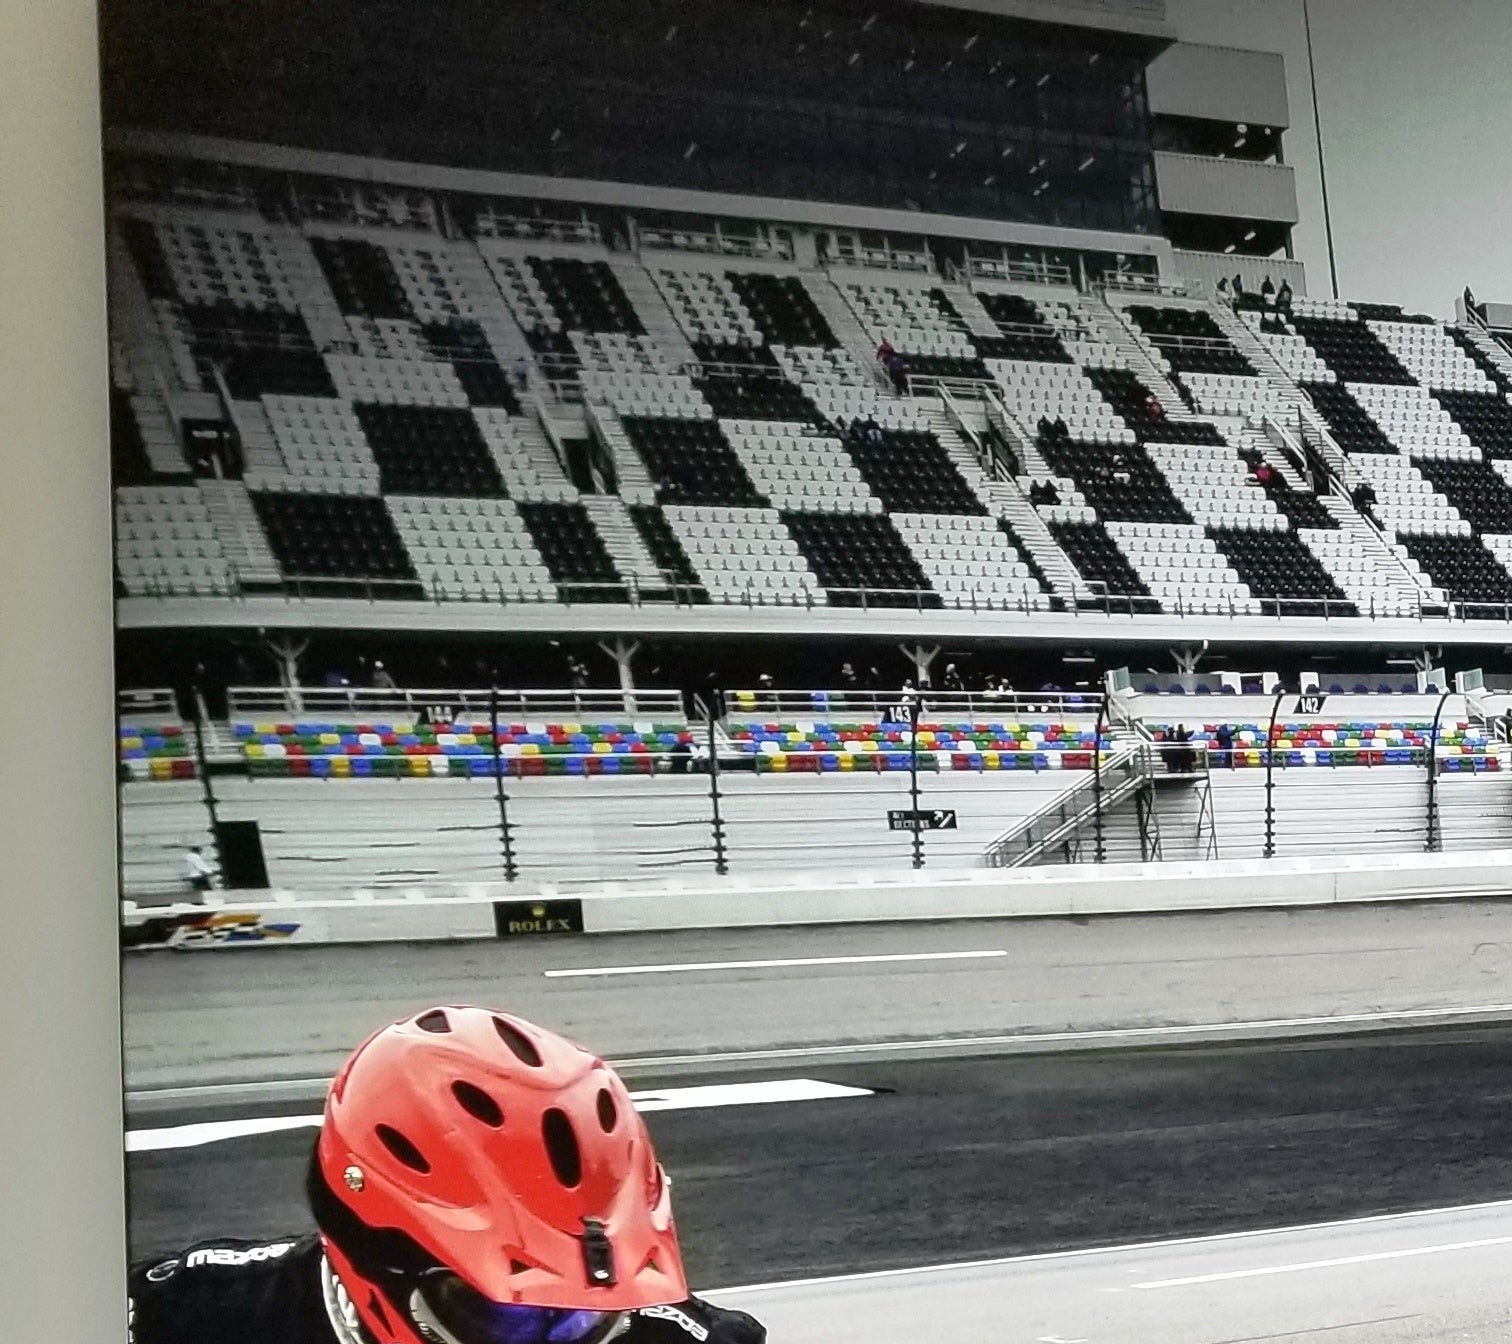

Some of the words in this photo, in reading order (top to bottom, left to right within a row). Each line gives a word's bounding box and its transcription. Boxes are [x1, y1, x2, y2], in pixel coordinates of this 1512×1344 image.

[1300, 697, 1319, 713] 142
[889, 706, 911, 722] 143
[508, 917, 571, 933] ROLEX
[187, 1242, 296, 1268] mazda
